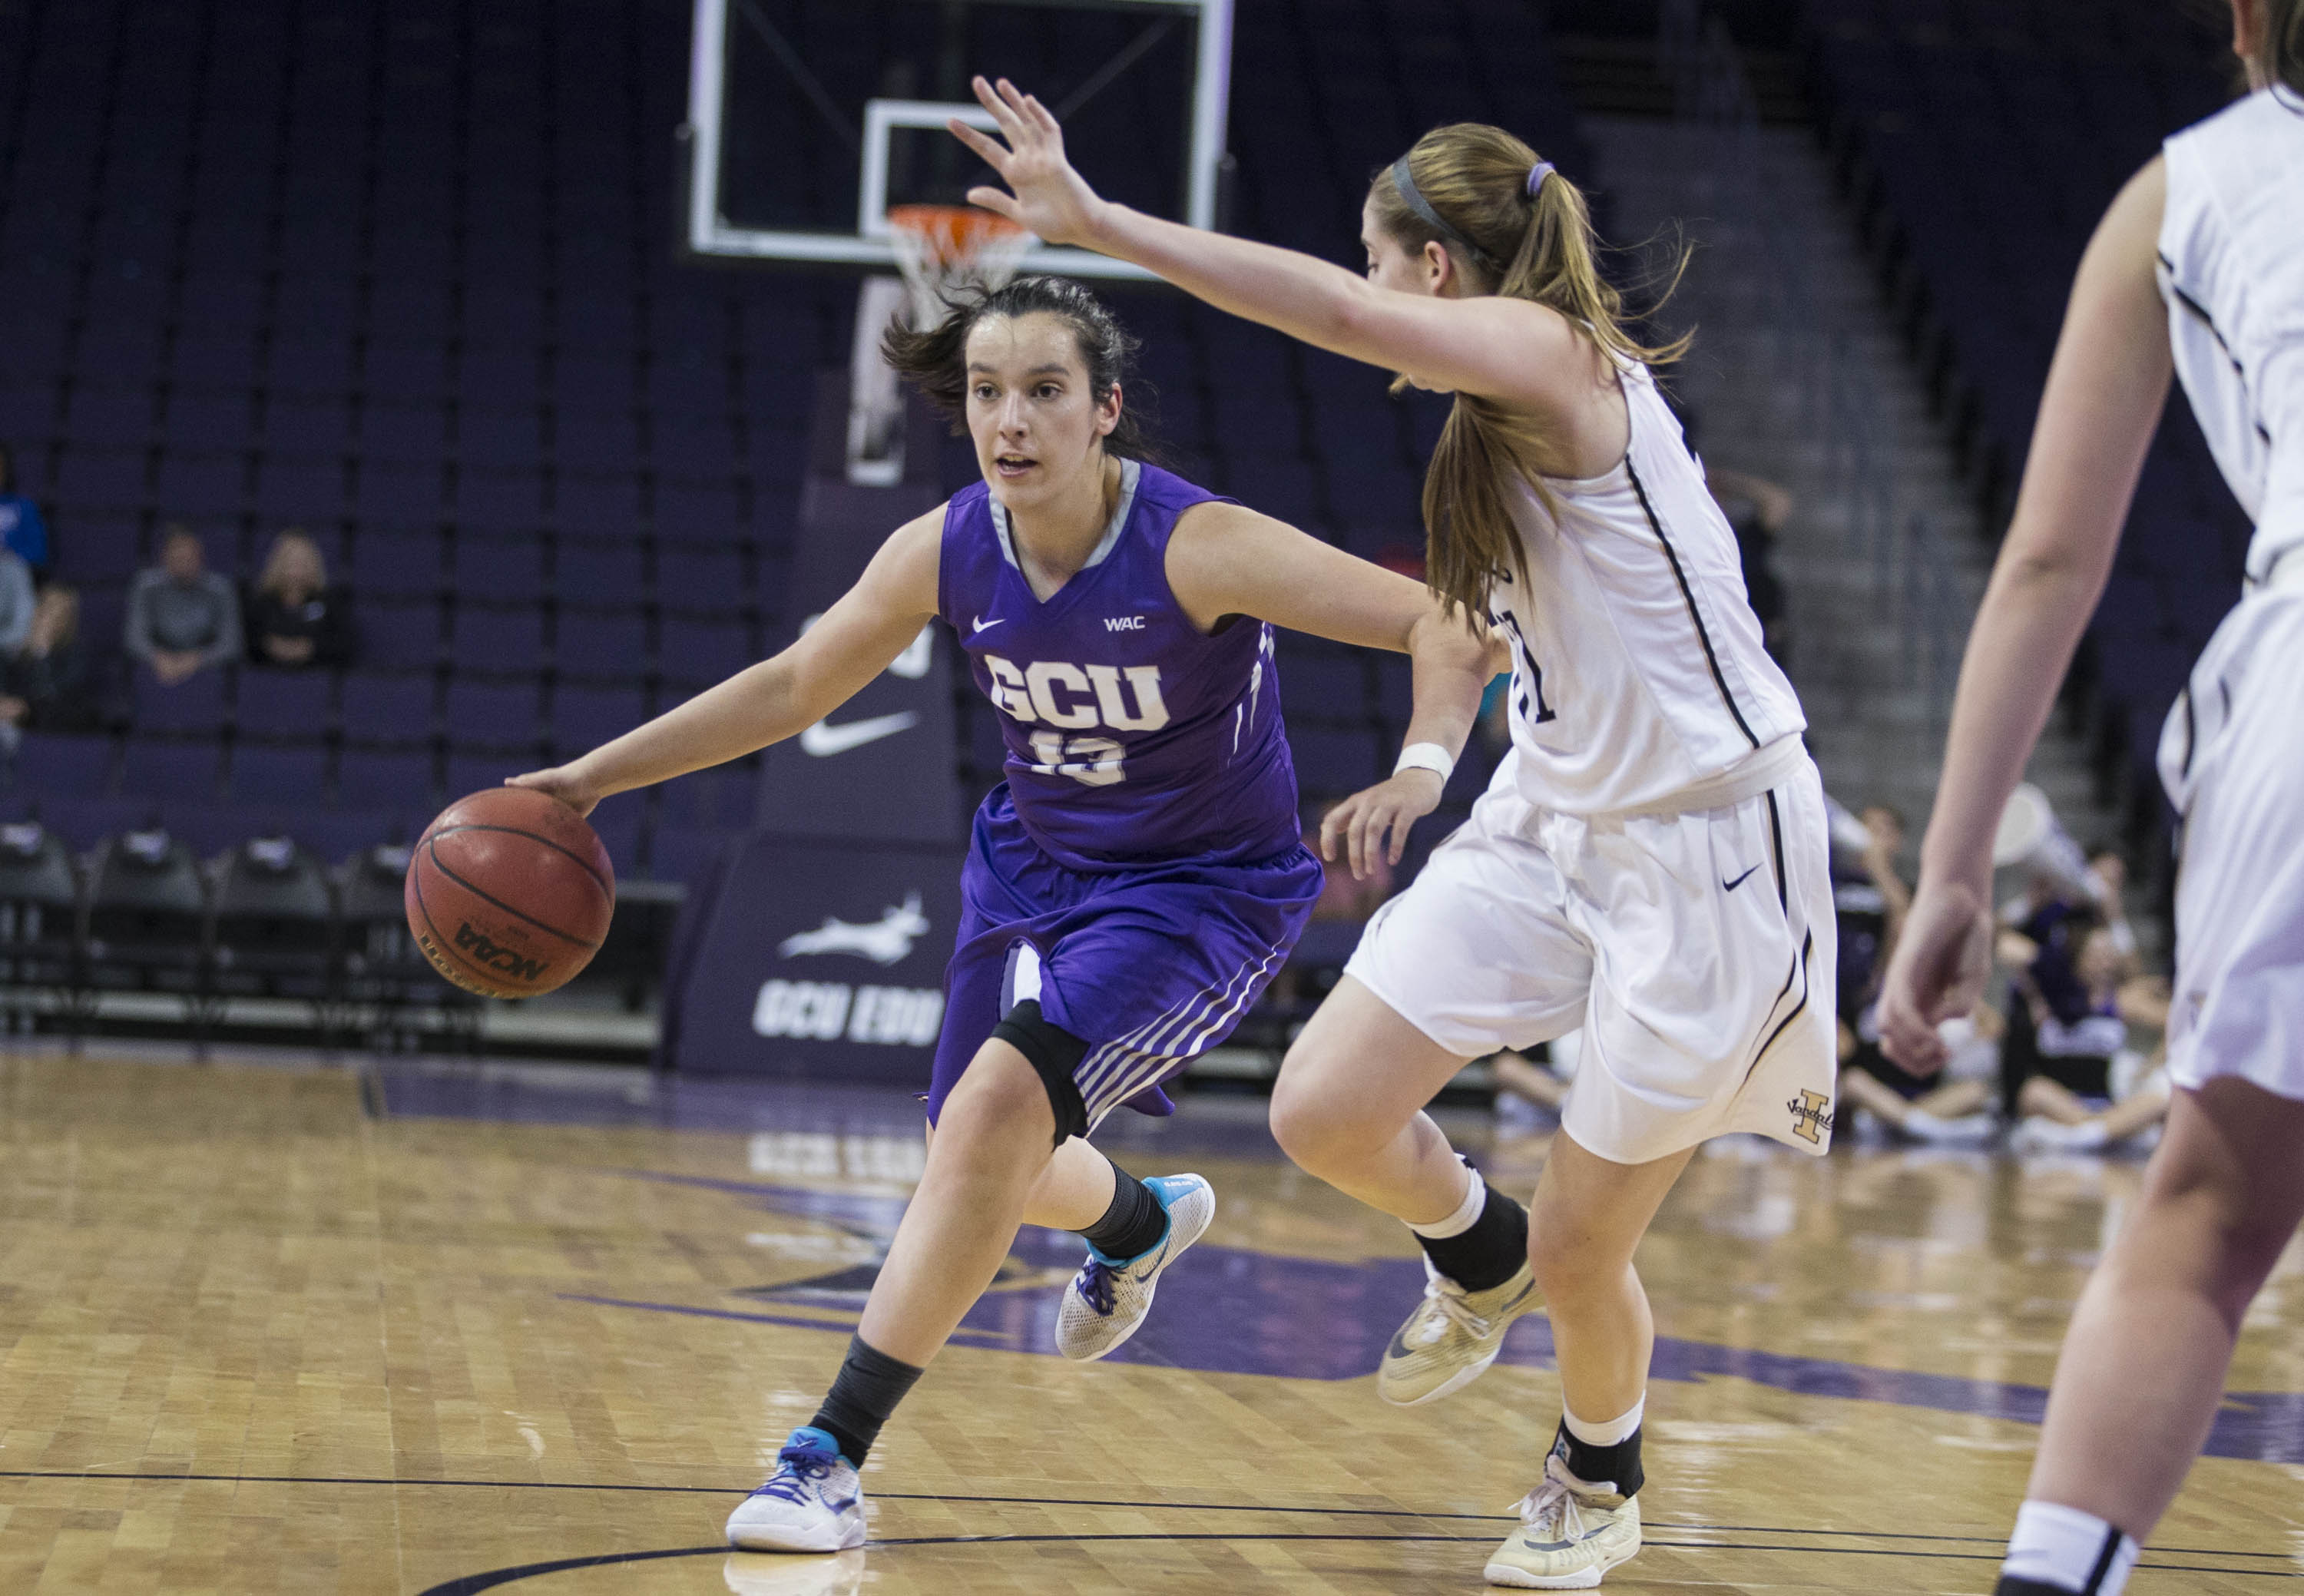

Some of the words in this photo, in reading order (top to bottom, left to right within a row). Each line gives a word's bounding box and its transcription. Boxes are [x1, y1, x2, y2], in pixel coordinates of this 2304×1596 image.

[1104, 616, 1146, 632] WAC
[984, 654, 1170, 731] GCU
[1029, 730, 1127, 787] 13
[455, 922, 550, 981] NCAA
